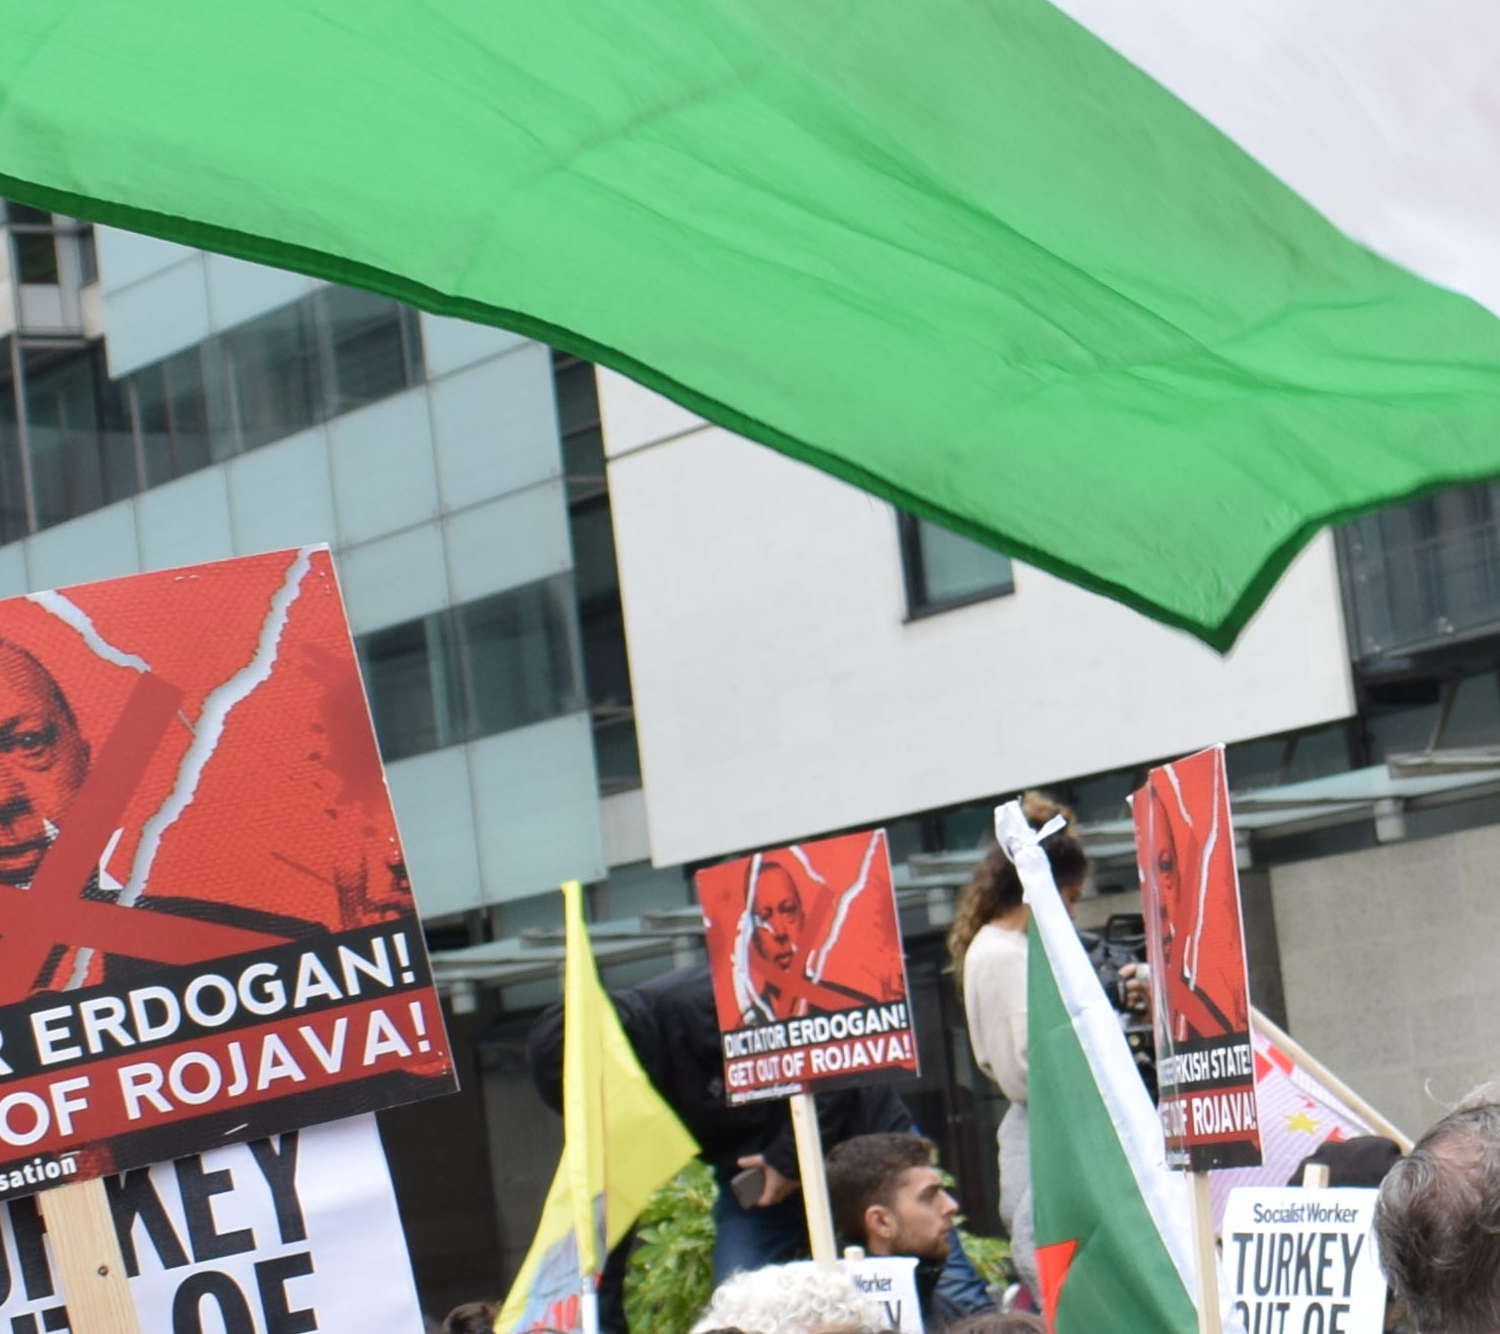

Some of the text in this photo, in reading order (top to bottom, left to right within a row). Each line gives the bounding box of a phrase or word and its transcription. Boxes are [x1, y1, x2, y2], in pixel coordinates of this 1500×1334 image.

[30, 932, 416, 1067] ERDOGAN!
[723, 1002, 908, 1059] DICTATOR ERDOGAN!
[117, 1001, 432, 1121] ROJAVA!
[727, 1034, 913, 1087] GET OUT OF ROJAVA!
[1191, 1091, 1258, 1136] ROJAVA!
[1253, 1202, 1359, 1224] Socialist Worker
[1232, 1232, 1365, 1298] TURKEY
